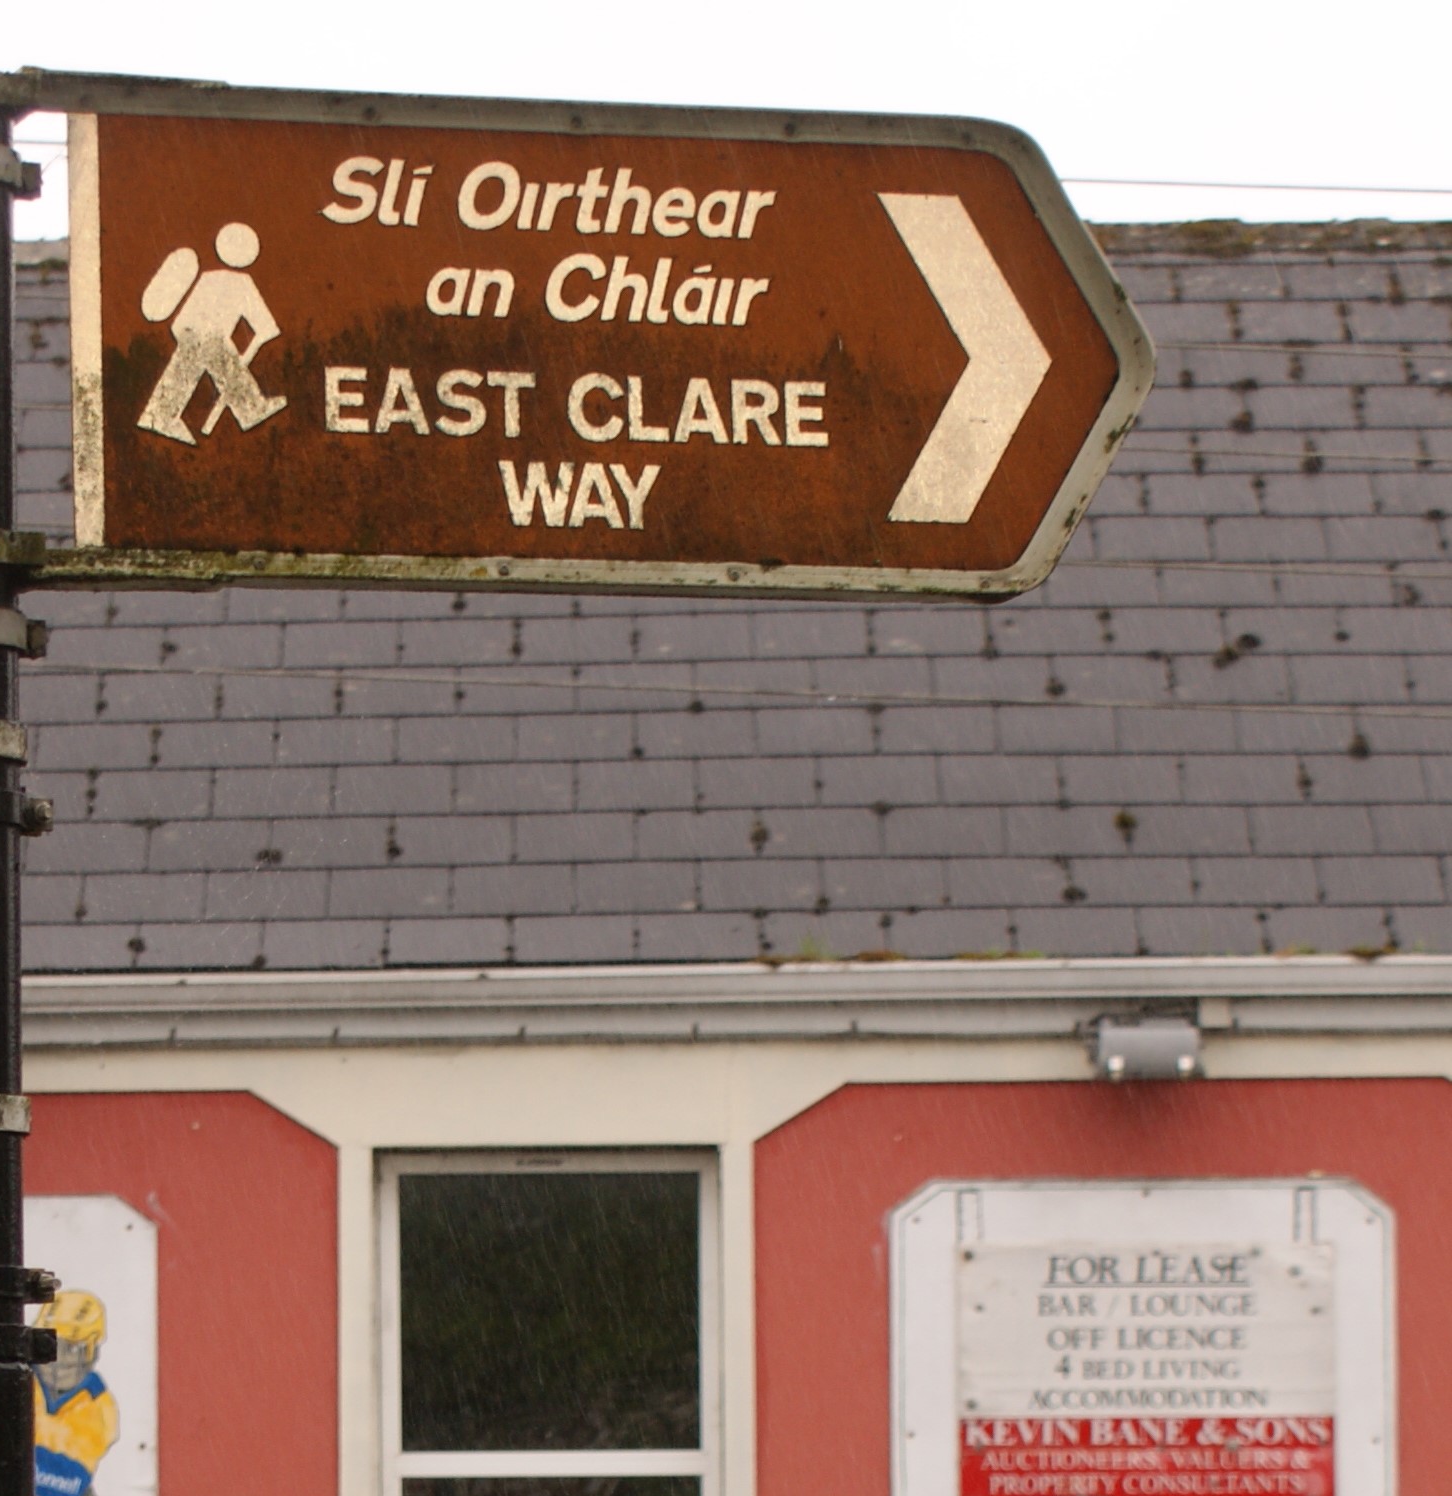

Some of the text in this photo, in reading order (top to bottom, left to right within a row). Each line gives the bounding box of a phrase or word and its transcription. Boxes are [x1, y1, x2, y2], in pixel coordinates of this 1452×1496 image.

[318, 154, 778, 241] Slí Oirthear
[425, 252, 770, 326] an Chláir
[323, 365, 831, 448] EAST CLARE
[497, 459, 662, 531] WAY
[1048, 1255, 1248, 1285] FOR LEASE
[1037, 1295, 1098, 1317] BAR
[1130, 1294, 1259, 1317] LOUNGE
[1046, 1326, 1248, 1350] OFF LICENCE
[1055, 1354, 1241, 1380] 4 BED LIVING
[1028, 1388, 1269, 1410] ACCOMMODATION
[964, 1418, 1331, 1447] KEVIN BANE & SONS
[988, 1472, 1308, 1496] PROPERTY CONSULTANTS
